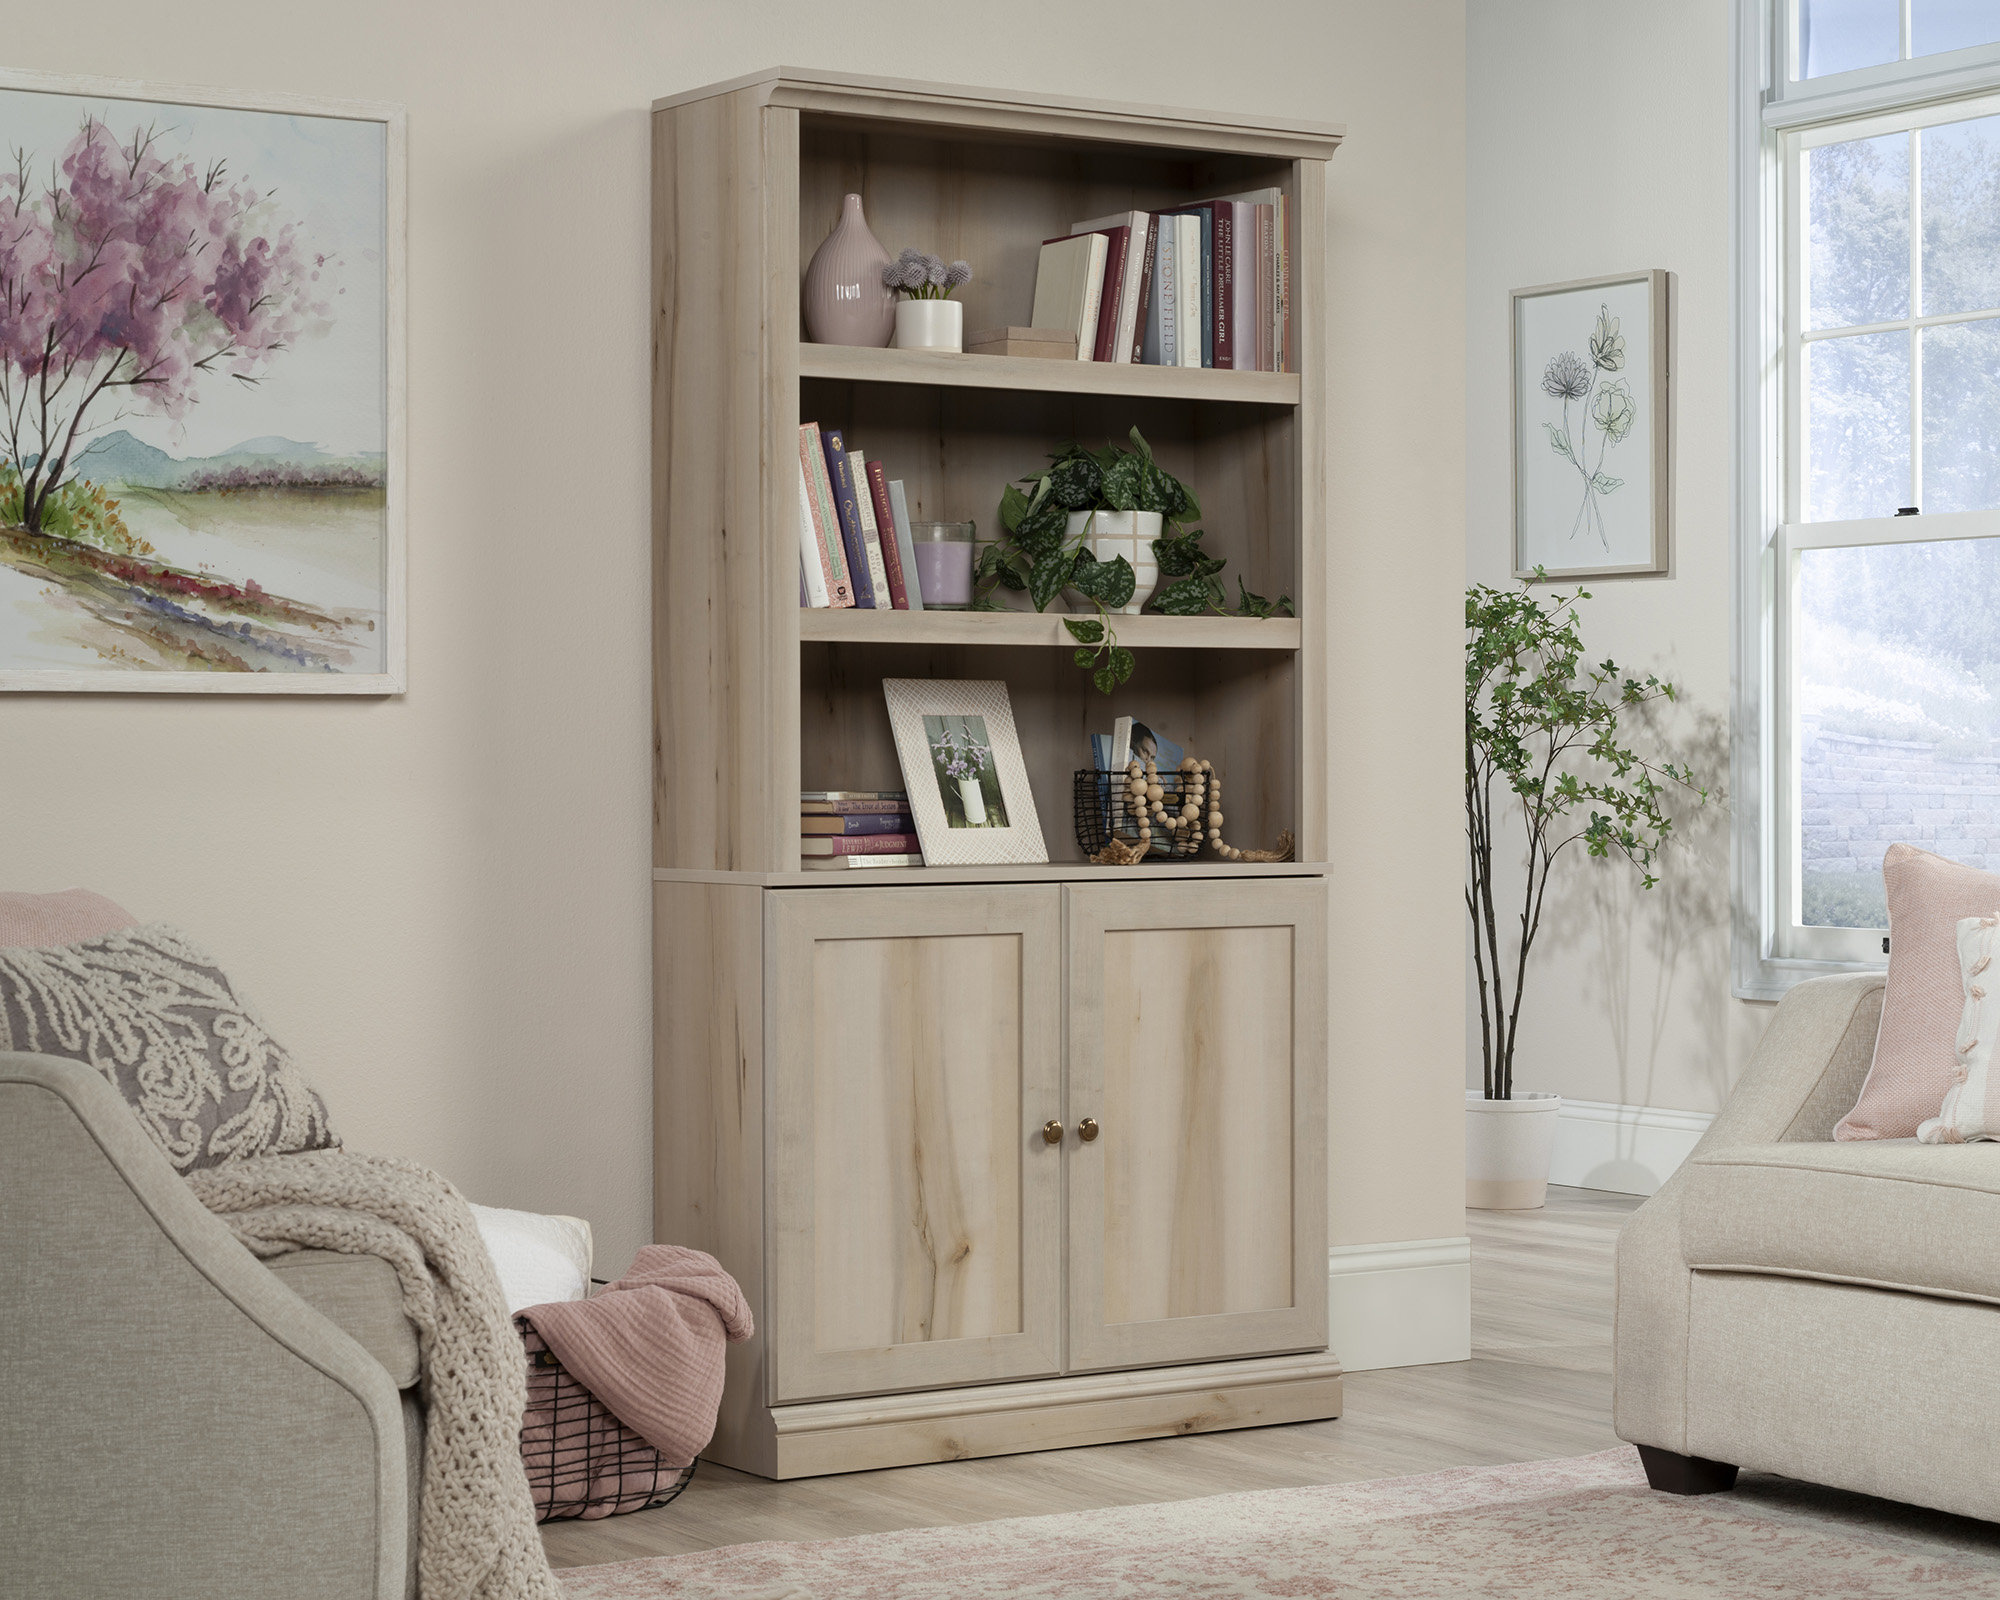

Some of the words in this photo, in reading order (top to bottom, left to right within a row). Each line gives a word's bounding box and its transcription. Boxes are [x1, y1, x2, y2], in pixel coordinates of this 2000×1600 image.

[1226, 246, 1231, 256] LE
[856, 458, 864, 484] NORA
[860, 486, 873, 528] ROBERTS
[880, 840, 907, 850] JUDGMENT
